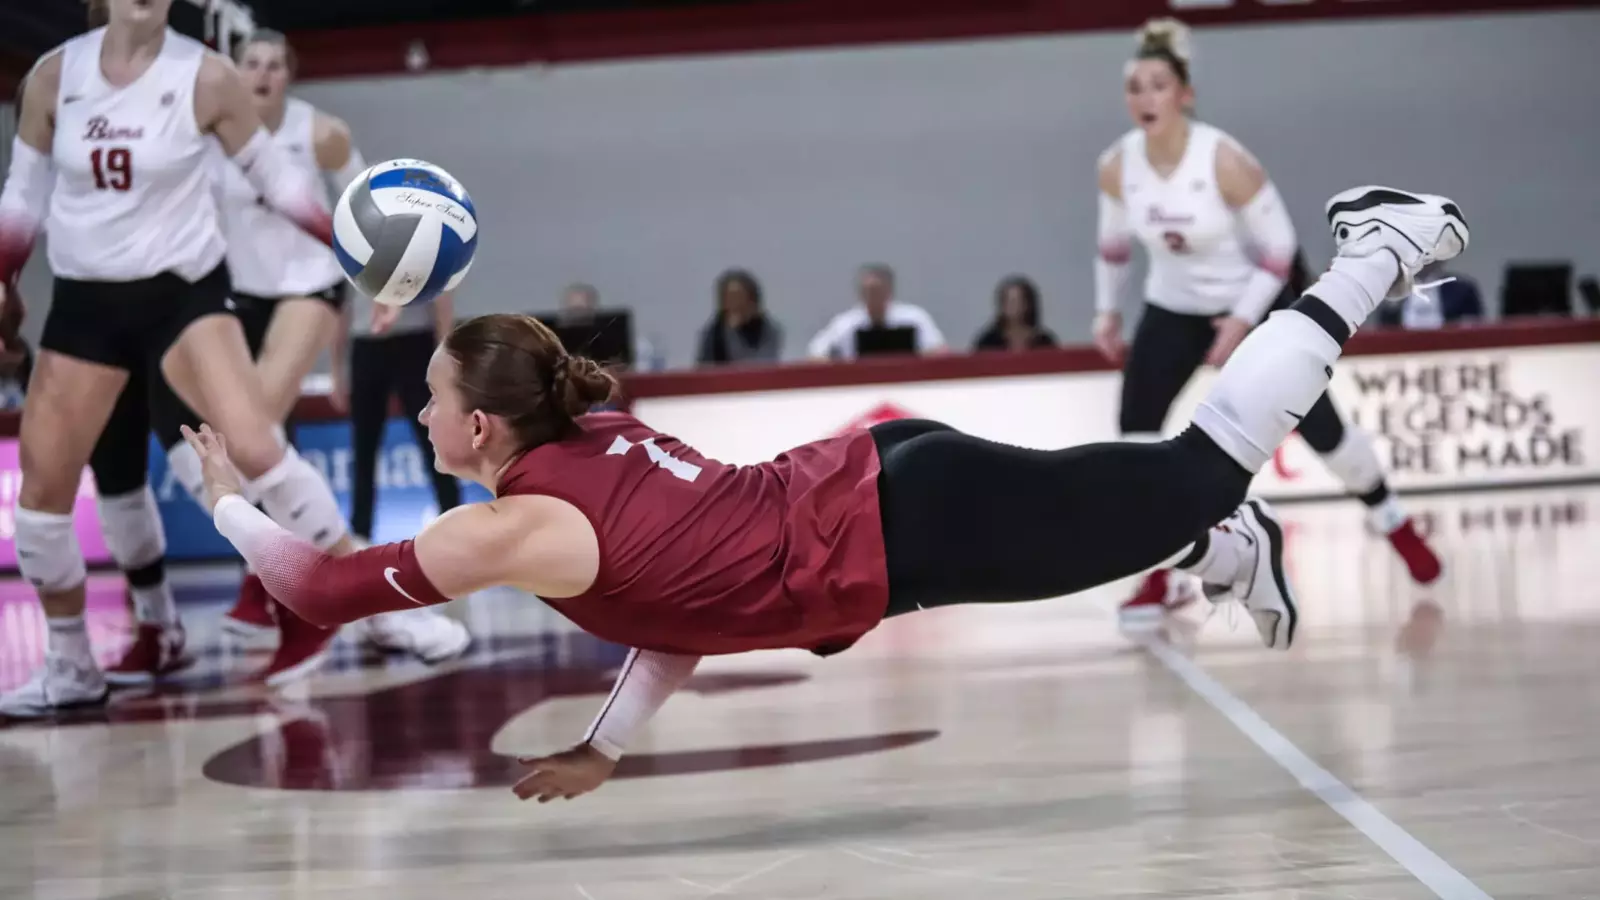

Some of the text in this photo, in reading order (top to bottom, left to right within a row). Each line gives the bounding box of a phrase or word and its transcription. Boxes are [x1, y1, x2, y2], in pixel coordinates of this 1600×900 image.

[91, 148, 132, 191] 19
[395, 191, 433, 209] Super
[1352, 364, 1503, 395] WHERE
[1390, 427, 1584, 471] RE MADE
